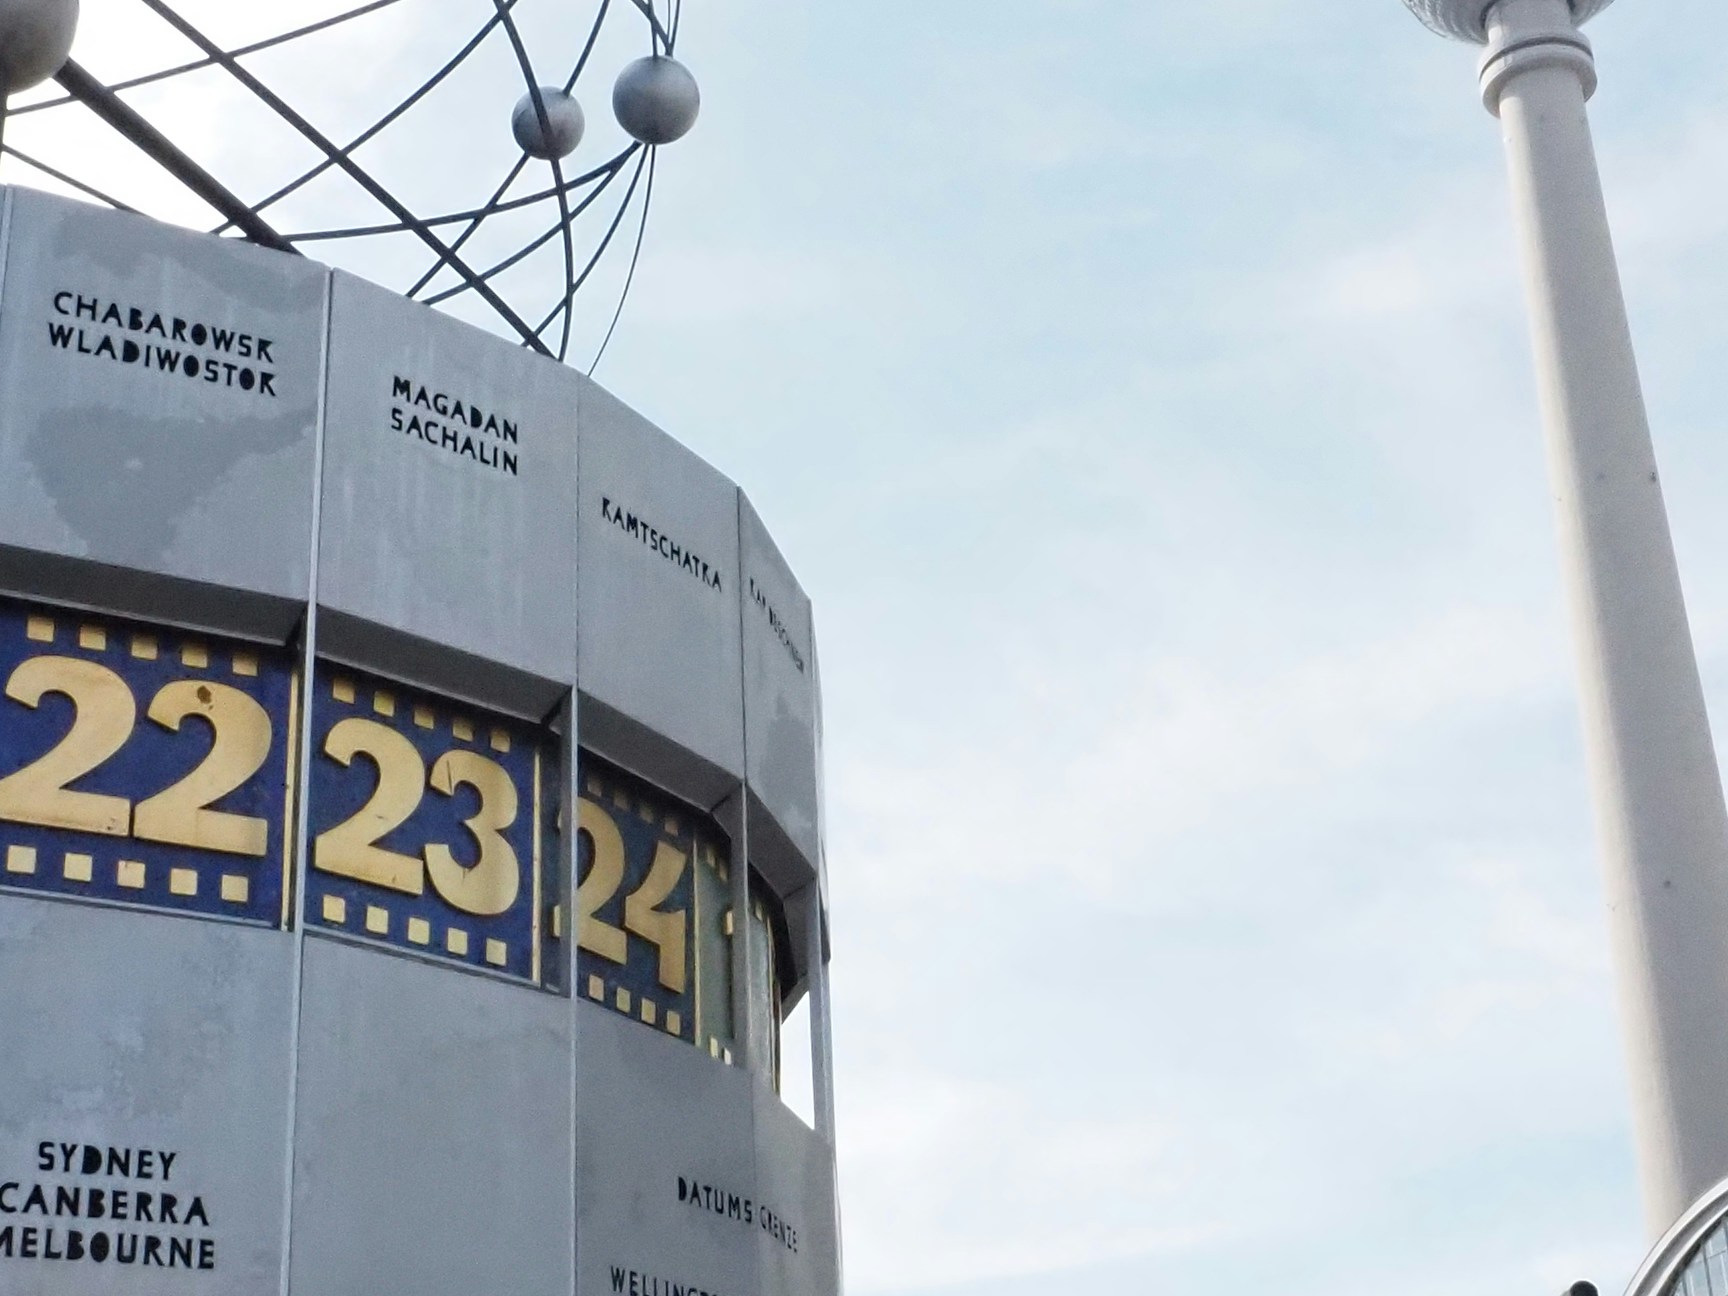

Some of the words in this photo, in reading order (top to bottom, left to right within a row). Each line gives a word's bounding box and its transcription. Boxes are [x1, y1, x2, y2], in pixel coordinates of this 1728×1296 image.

[48, 322, 276, 396] WLADIWOSTOK
[53, 291, 275, 364] CHABAROWSK
[390, 409, 519, 477] SACHALIN
[392, 375, 519, 445] MAGADAN
[601, 497, 722, 593] KAMTSCHATKA
[314, 717, 519, 916] 23
[557, 796, 685, 994] 24
[38, 1141, 176, 1181] SYDNEY
